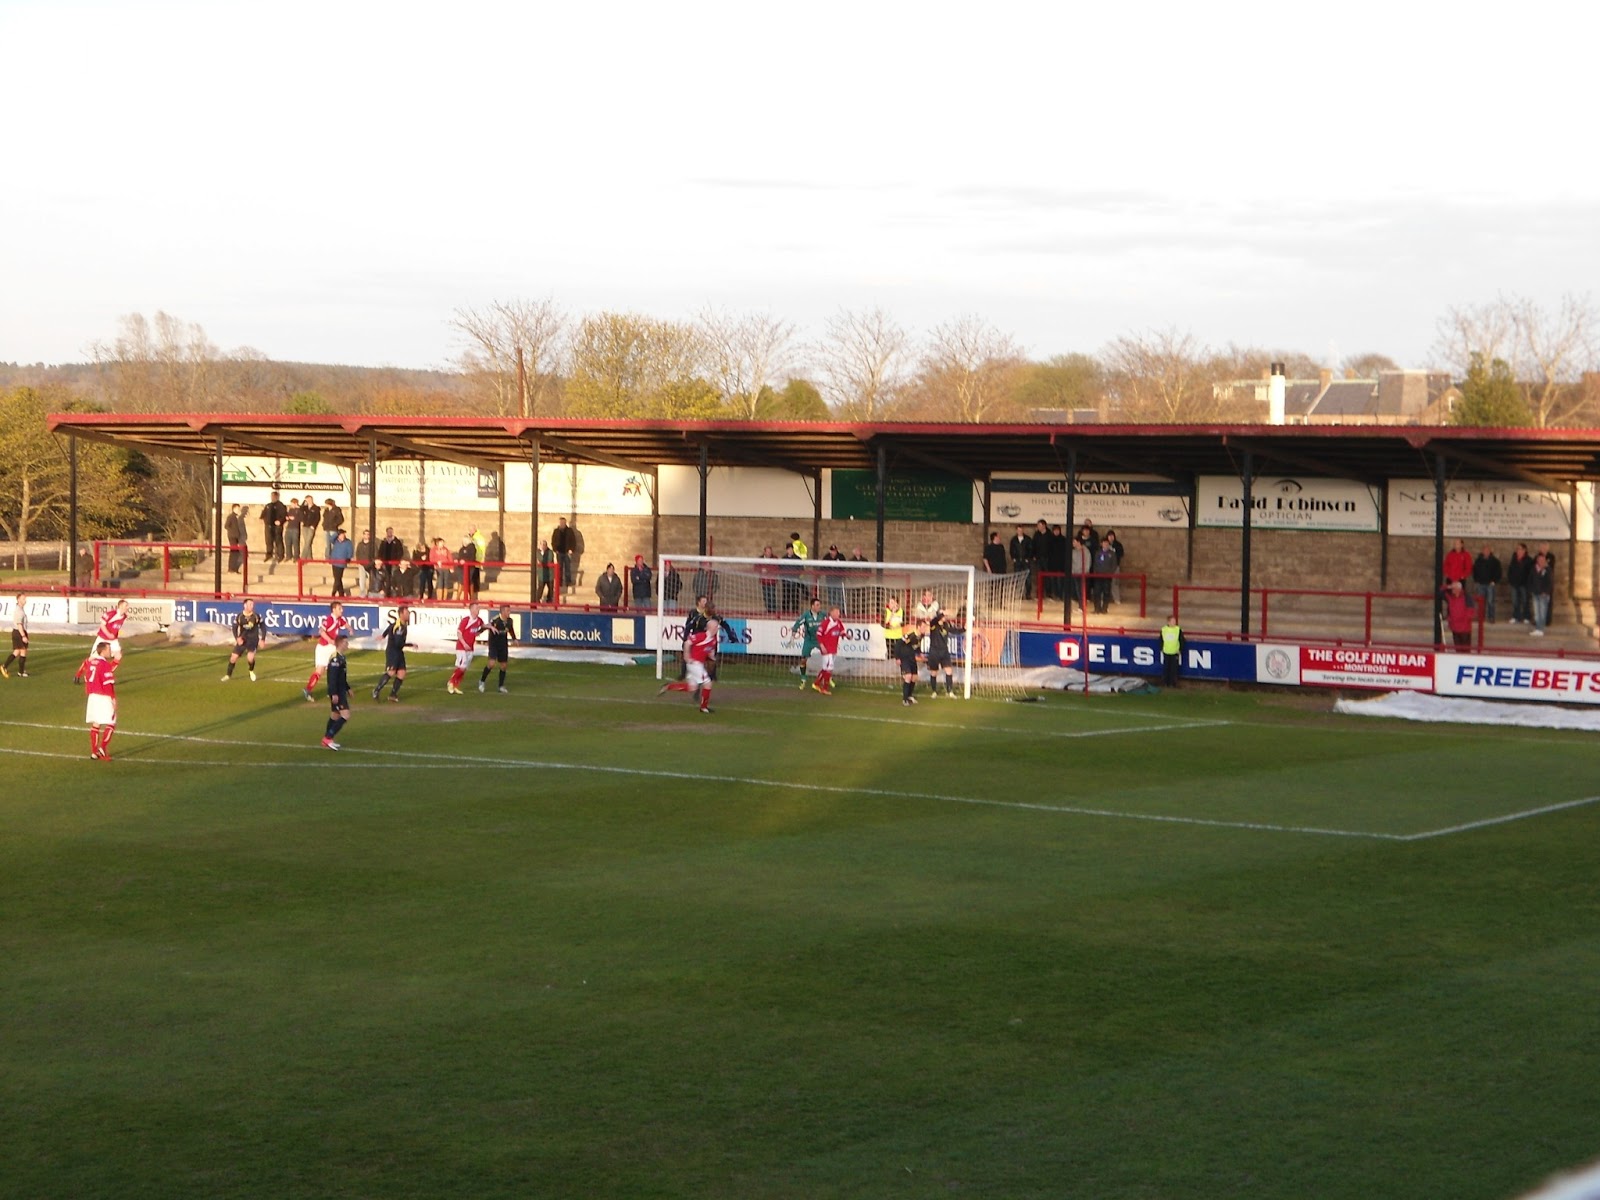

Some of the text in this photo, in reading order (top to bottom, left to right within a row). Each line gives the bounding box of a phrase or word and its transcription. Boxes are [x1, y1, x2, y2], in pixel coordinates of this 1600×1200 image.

[1048, 481, 1130, 494] GLNCADAM
[1032, 498, 1079, 506] HIGHLAD
[1277, 498, 1356, 512] Robinson
[1259, 512, 1312, 520] OPTICIAN
[265, 609, 280, 627] &
[531, 627, 601, 641] savills.co.uk
[1059, 642, 1212, 669] DELSN
[1308, 649, 1427, 667] THE GOLF INN BAR
[1344, 663, 1388, 673] MONTROSE
